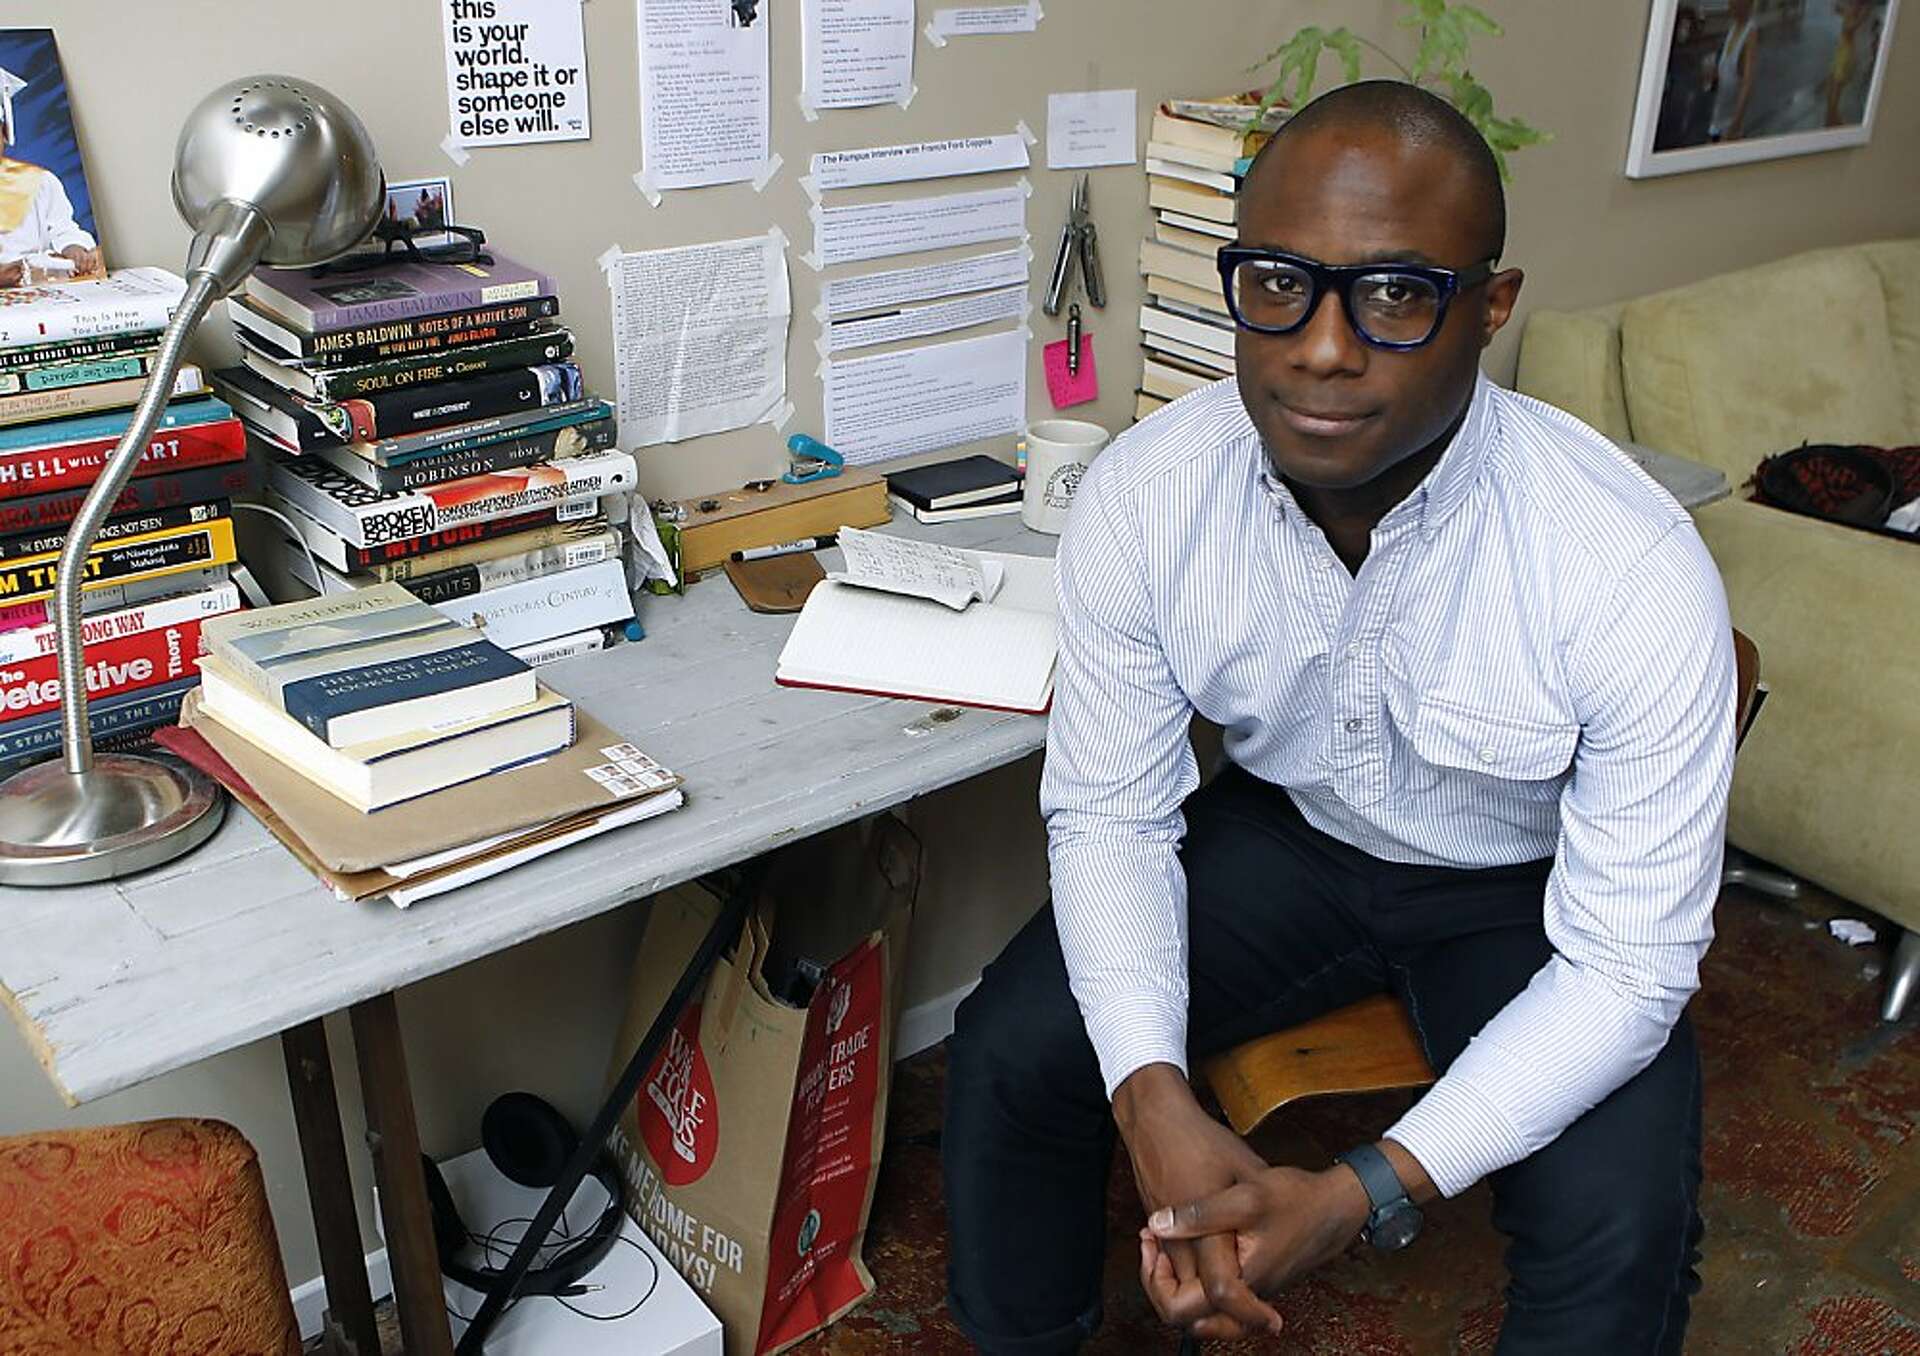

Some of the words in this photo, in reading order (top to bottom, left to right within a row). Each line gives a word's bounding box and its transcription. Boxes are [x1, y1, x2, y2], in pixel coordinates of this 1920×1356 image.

[451, 0, 496, 19] this
[452, 20, 472, 43] is
[479, 22, 529, 46] your
[456, 42, 529, 66] world.
[456, 67, 528, 96] shape
[534, 64, 550, 86] it
[555, 68, 577, 85] or
[458, 91, 565, 114] someone
[460, 114, 508, 136] else
[516, 111, 559, 132] will.
[823, 154, 838, 164] The
[839, 152, 870, 163] Rumpus
[871, 148, 903, 159] Interview
[74, 314, 97, 324] This
[346, 303, 397, 323] JAMES
[400, 290, 474, 317] BALDWIN
[314, 332, 353, 353] JAMES
[357, 323, 414, 346] BALDWIN
[419, 320, 450, 333] NOTES
[451, 316, 463, 329] OF
[475, 309, 506, 325] NATIVE
[508, 306, 527, 320] SON
[356, 375, 393, 392] SOUL
[395, 370, 414, 385] ON
[418, 366, 444, 381] FIRE
[0, 457, 66, 483] HELL
[68, 456, 100, 468] WILL
[105, 440, 180, 462] SART
[404, 458, 495, 487] ROBINSON
[361, 504, 434, 532] BROKEN
[570, 475, 602, 491] AITKEN
[34, 535, 66, 552] EVIDEN
[95, 525, 121, 539] INGS
[140, 518, 163, 532] SEEN
[364, 521, 435, 545] SCREEN
[411, 577, 473, 602] TRAITS
[82, 618, 114, 641] ONG
[114, 611, 145, 634] WAY
[165, 628, 183, 679] Thorp
[318, 672, 361, 689] THE
[364, 660, 416, 681] FIRST
[422, 648, 475, 666] FOUR
[0, 658, 153, 713] etetive
[325, 677, 394, 698] BOOKS
[397, 671, 419, 684] OF
[426, 655, 488, 676] POEMS
[16, 721, 96, 748] STRANR
[102, 714, 119, 727] IN
[124, 706, 152, 721] THE
[830, 1025, 871, 1067] TRADE
[627, 1151, 655, 1202] ME
[649, 1179, 698, 1248] HOME
[702, 1224, 744, 1275] FOR
